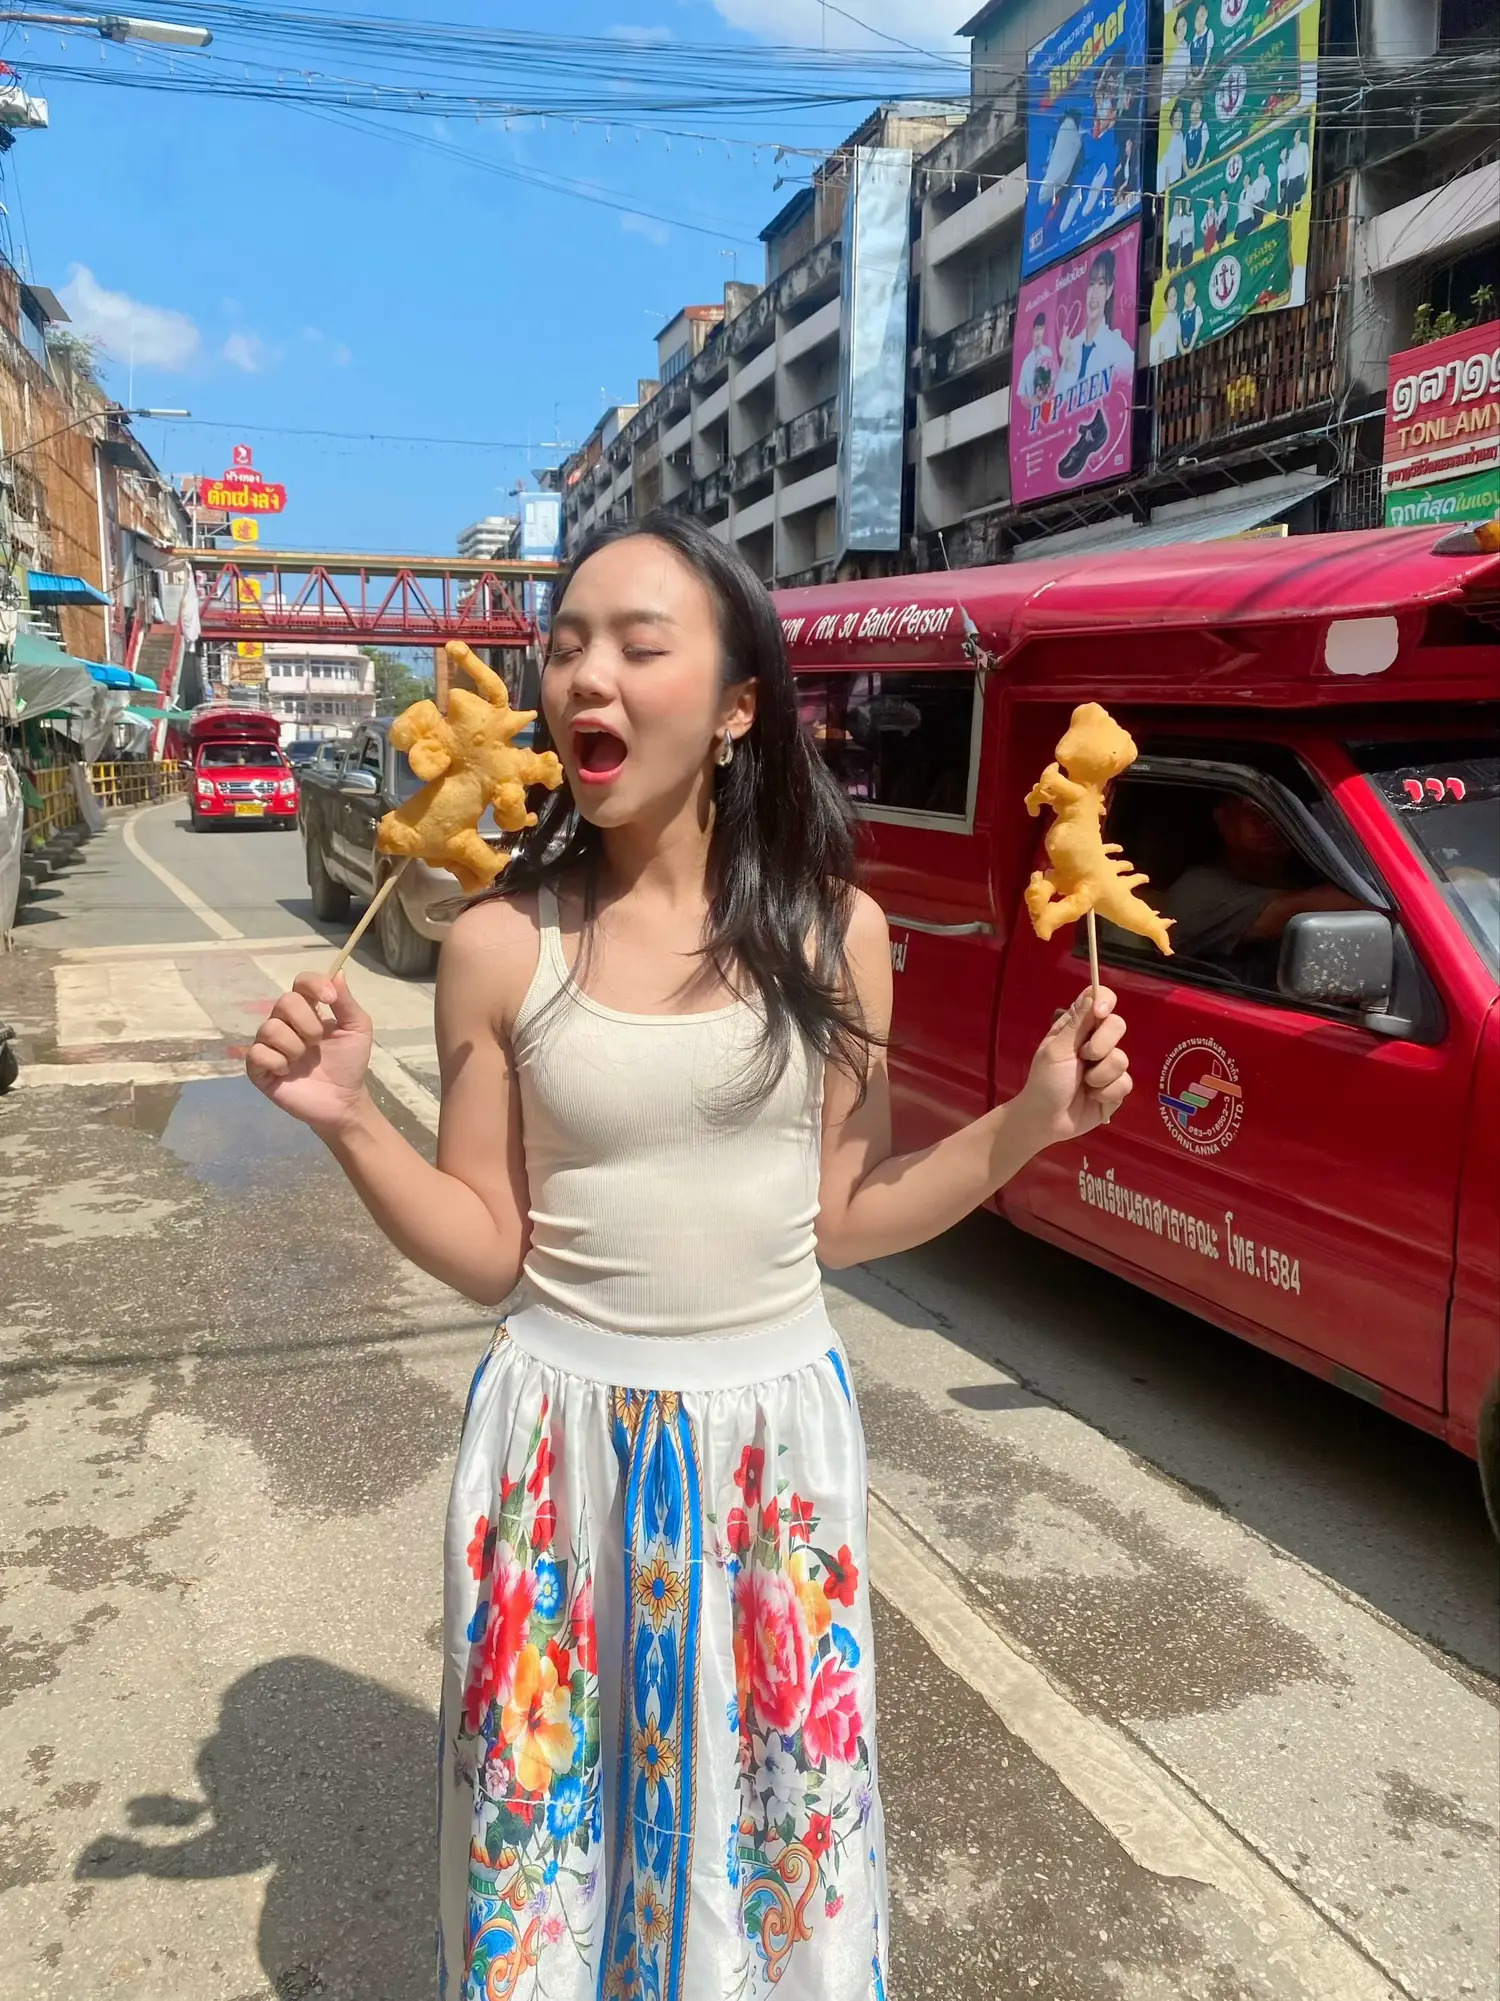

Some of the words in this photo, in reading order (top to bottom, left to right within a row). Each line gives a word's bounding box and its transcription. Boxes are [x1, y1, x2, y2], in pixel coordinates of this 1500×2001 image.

[1159, 1106, 1221, 1156] NAKORNLANNA
[1078, 1155, 1220, 1260] ร้องเรียนรถสาธารณะ
